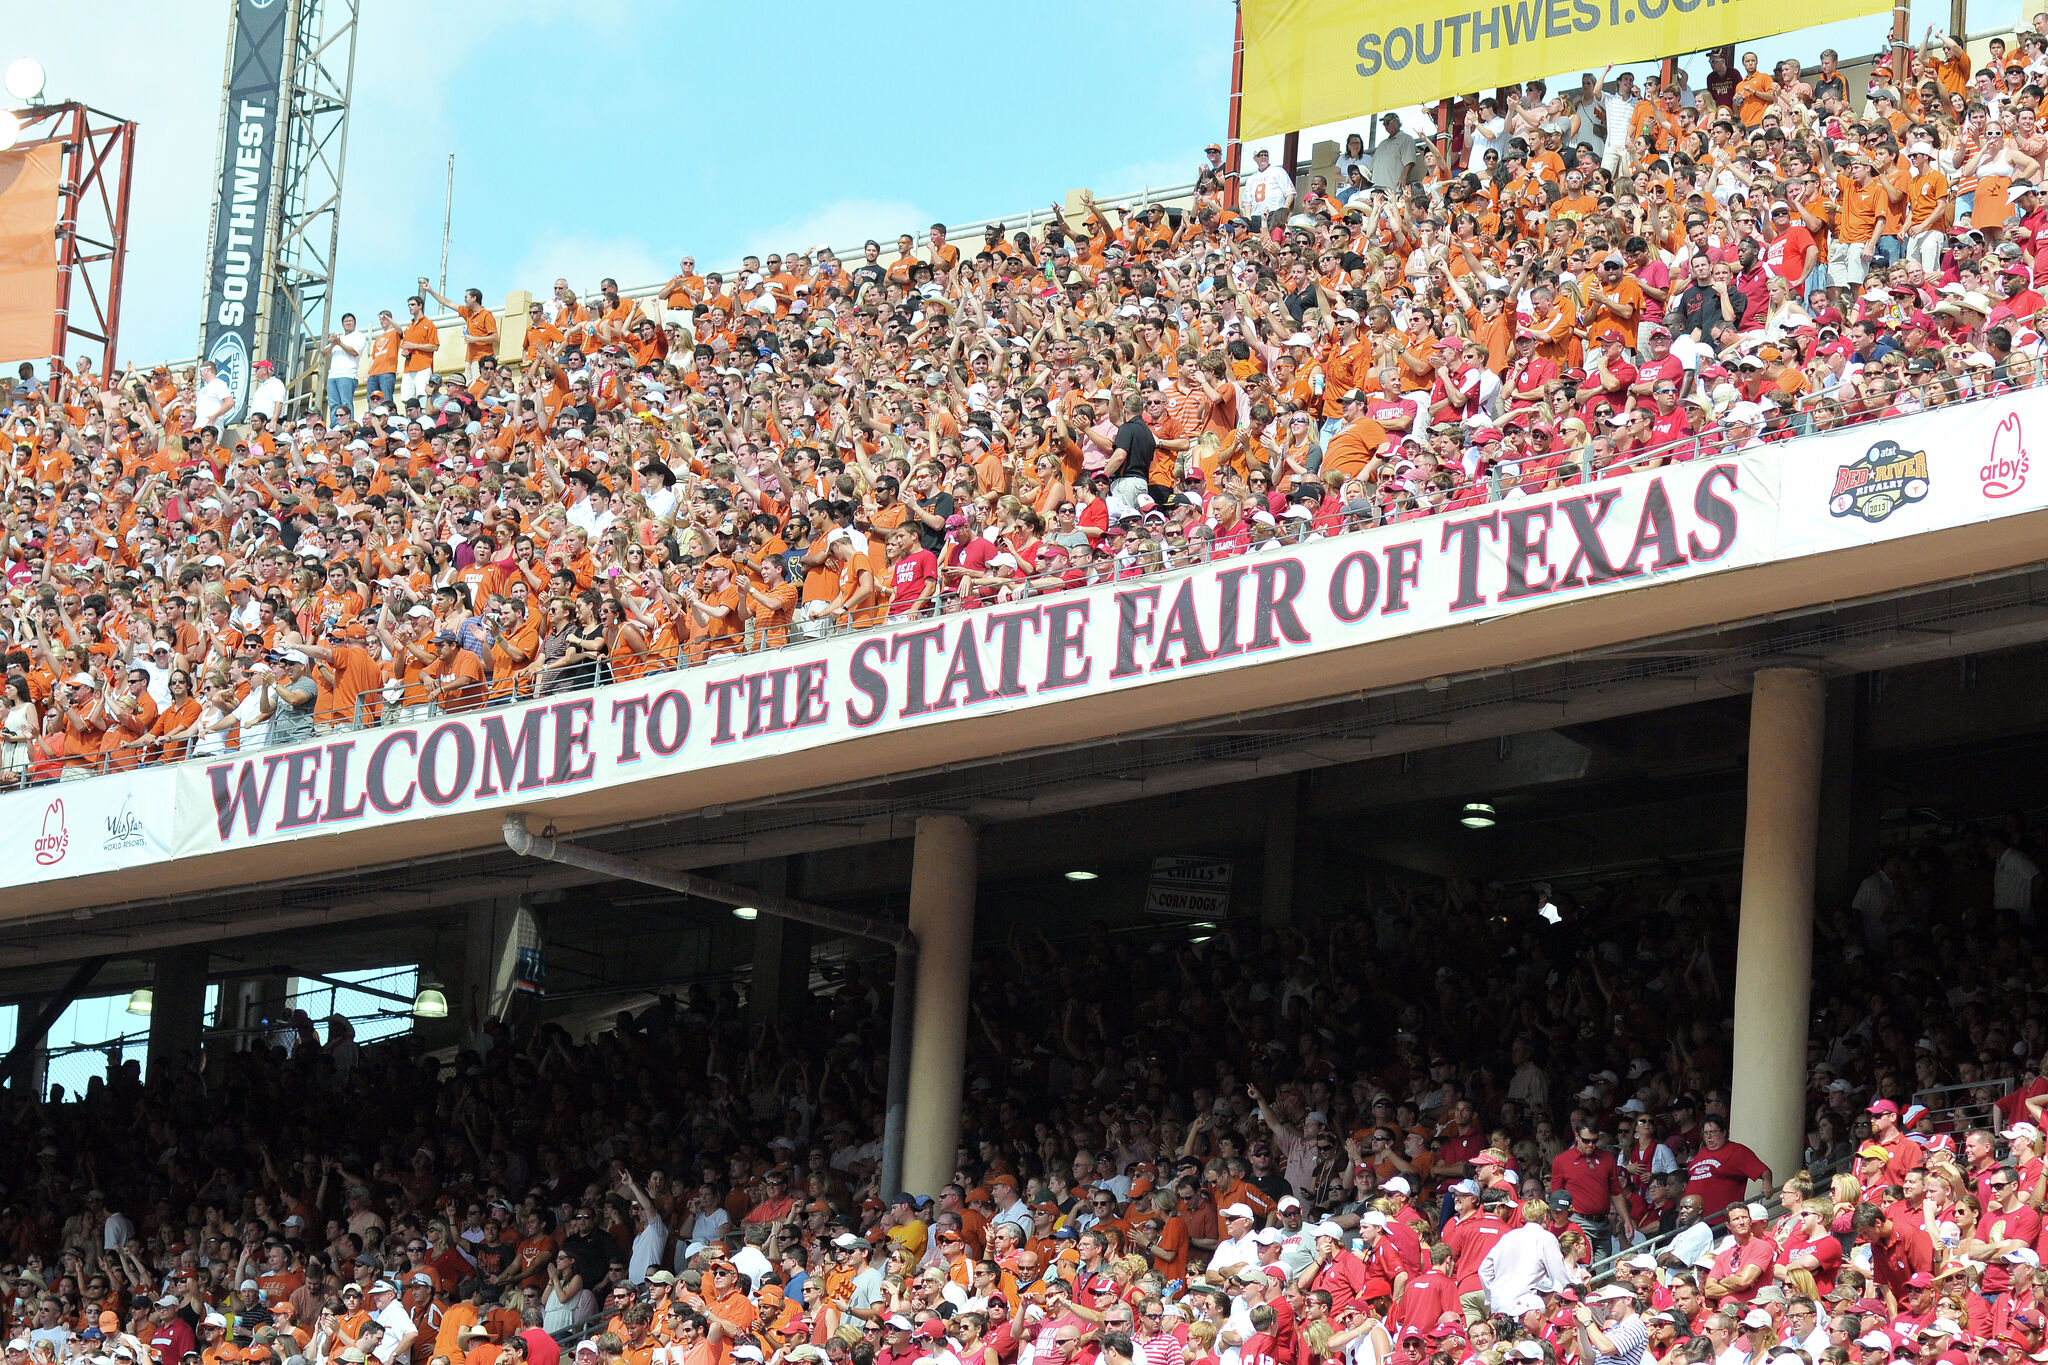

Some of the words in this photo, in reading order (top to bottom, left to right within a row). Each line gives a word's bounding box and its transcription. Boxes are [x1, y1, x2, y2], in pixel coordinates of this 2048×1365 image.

[1254, 183, 1266, 203] 8
[218, 99, 266, 327] SOUTHWEST
[231, 352, 240, 408] PORTS
[1832, 467, 1869, 497] RED
[1874, 451, 1927, 482] RIVER
[1980, 454, 2029, 482] arby's
[1856, 479, 1903, 496] RIVALRY
[1869, 503, 1886, 513] 2013
[464, 573, 484, 583] TEXAS
[896, 561, 918, 575] BEAT
[207, 697, 597, 842] WELCOME
[611, 690, 691, 767] TO
[705, 659, 830, 747] THE
[846, 597, 1092, 729] STATE
[1109, 557, 1310, 680] FAIR
[1327, 538, 1421, 623] OF
[1440, 462, 1739, 613] TEXAS
[105, 812, 143, 840] WinStar
[35, 829, 69, 852] arby's
[103, 843, 122, 851] WORLD
[123, 838, 145, 849] RESORTS
[1158, 893, 1187, 909] CORN
[1189, 896, 1216, 912] DOGS
[263, 1282, 286, 1290] TEXAS
